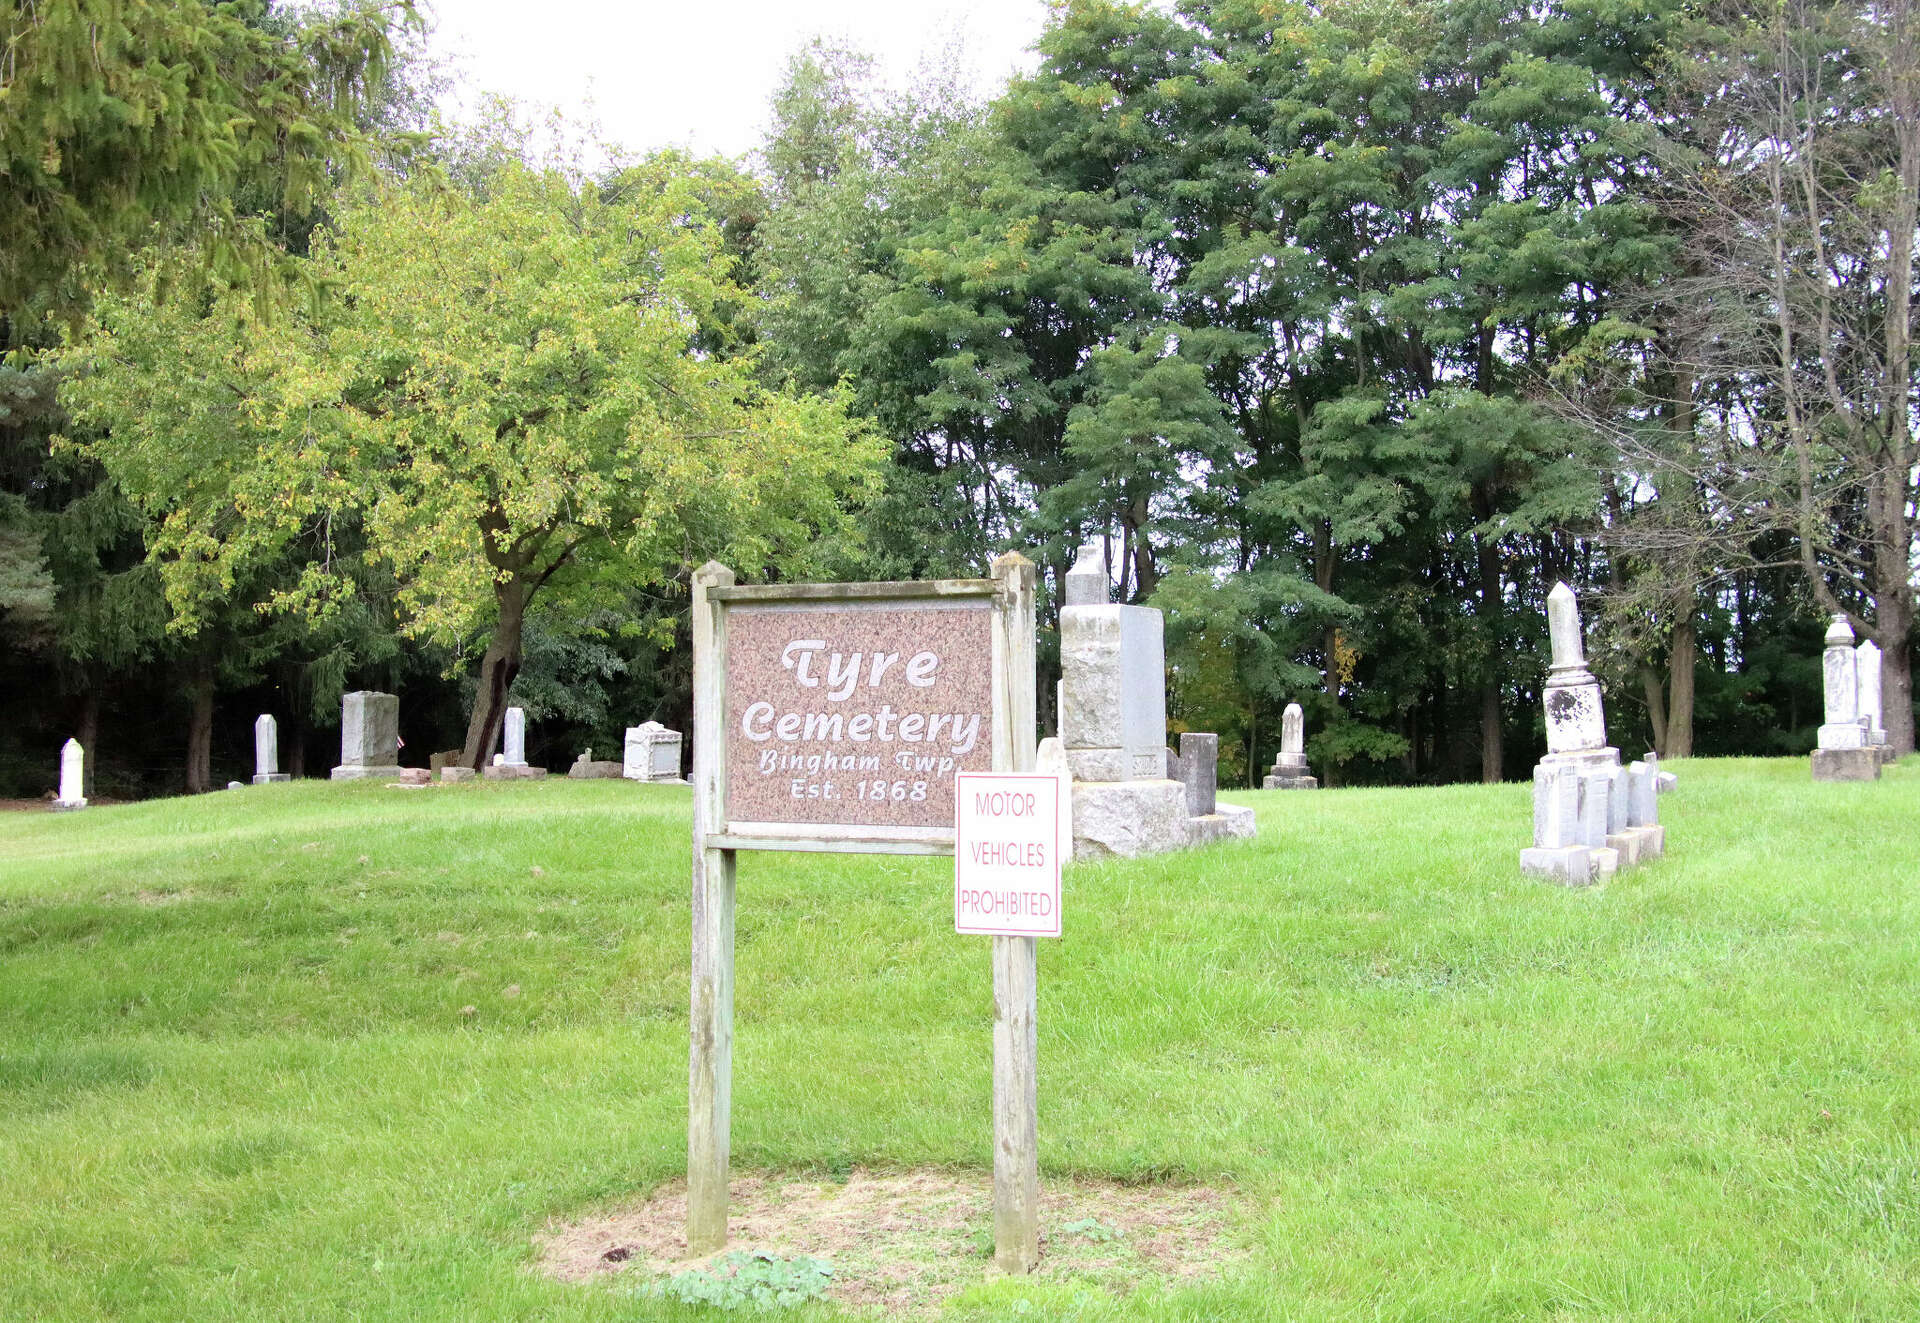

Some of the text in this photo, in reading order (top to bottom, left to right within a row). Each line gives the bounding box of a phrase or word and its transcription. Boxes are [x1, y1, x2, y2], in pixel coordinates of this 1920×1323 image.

[781, 639, 939, 701] Tyre
[742, 701, 981, 755] Cemetery
[759, 746, 880, 775] Bingham
[790, 778, 928, 801] Est. 1868
[975, 791, 1036, 817] MOTOR
[971, 841, 1046, 867] VEHICLES
[961, 889, 1053, 916] PROHIBITED
